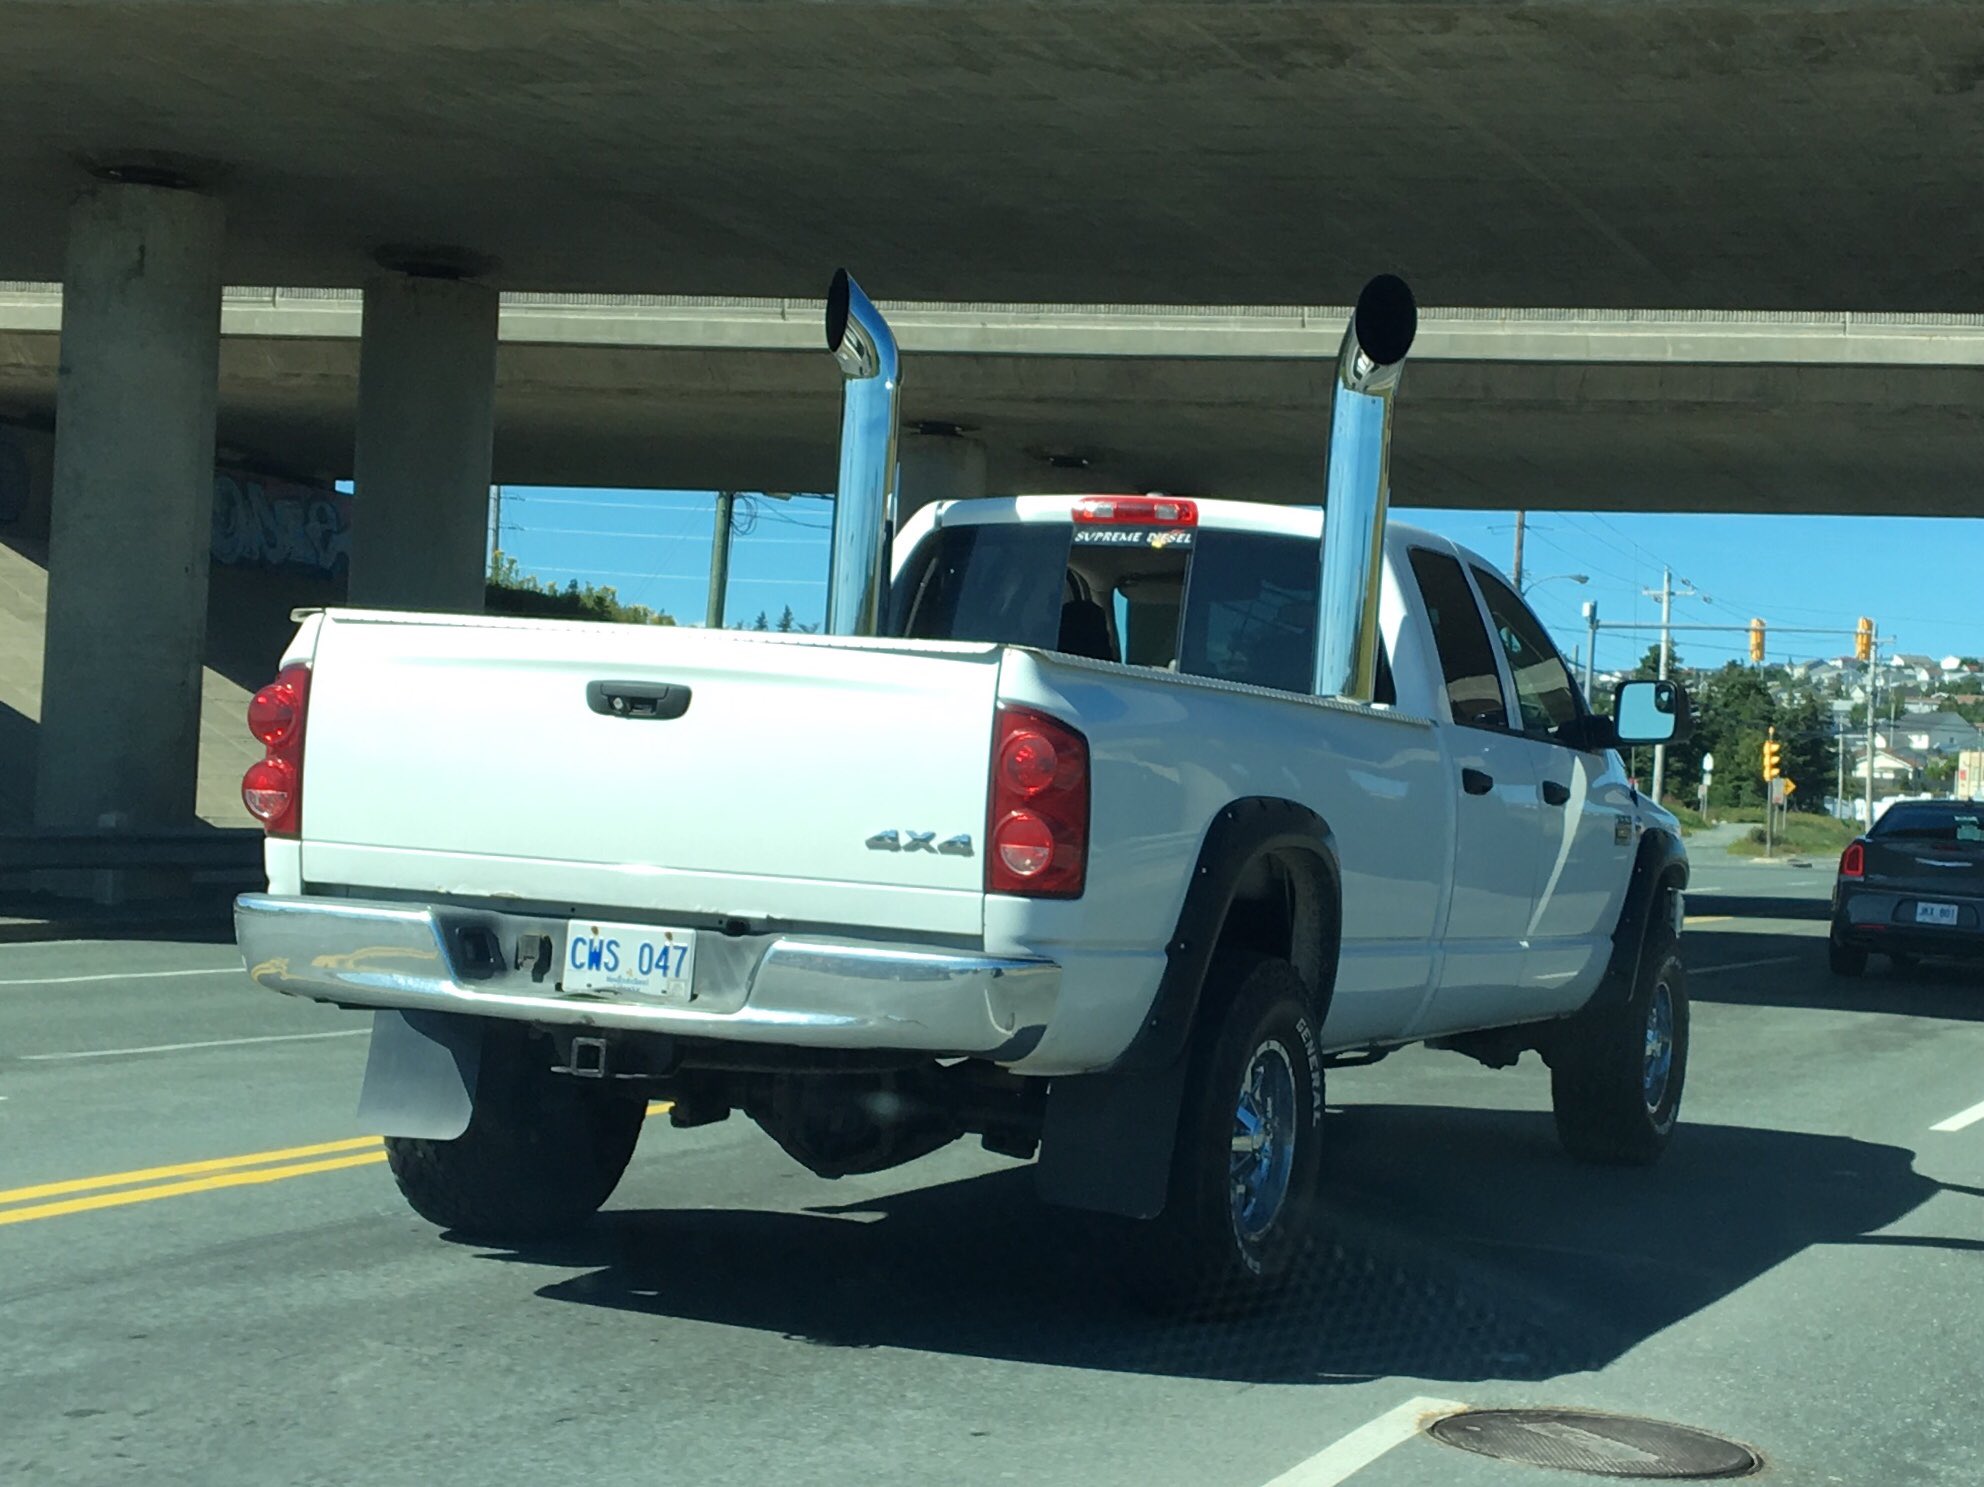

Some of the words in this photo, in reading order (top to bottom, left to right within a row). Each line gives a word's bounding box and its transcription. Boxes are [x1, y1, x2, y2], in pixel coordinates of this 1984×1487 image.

[1074, 530, 1143, 543] SUPREME
[570, 936, 620, 973] CWS
[638, 942, 688, 978] 047
[1296, 1017, 1321, 1127] GENERAL
